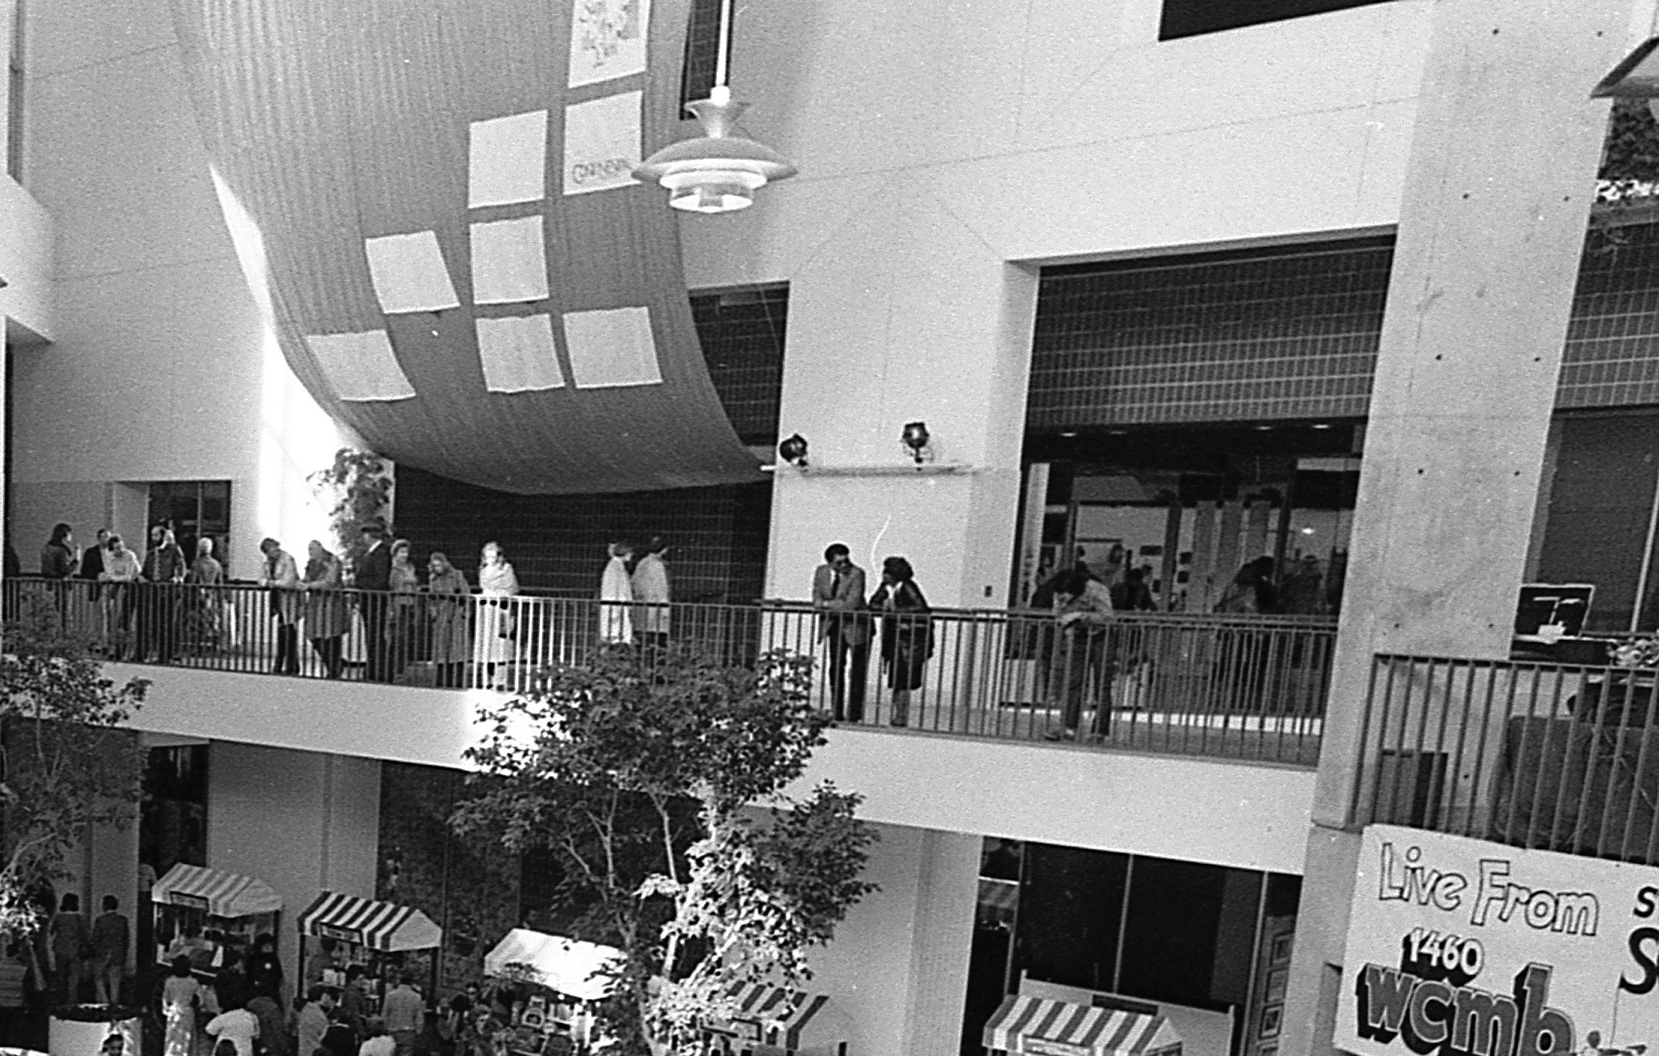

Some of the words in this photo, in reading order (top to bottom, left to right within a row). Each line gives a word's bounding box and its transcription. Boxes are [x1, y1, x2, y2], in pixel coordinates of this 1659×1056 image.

[1378, 842, 1468, 912] Live
[1470, 858, 1600, 937] From
[1403, 927, 1485, 977] 1460
